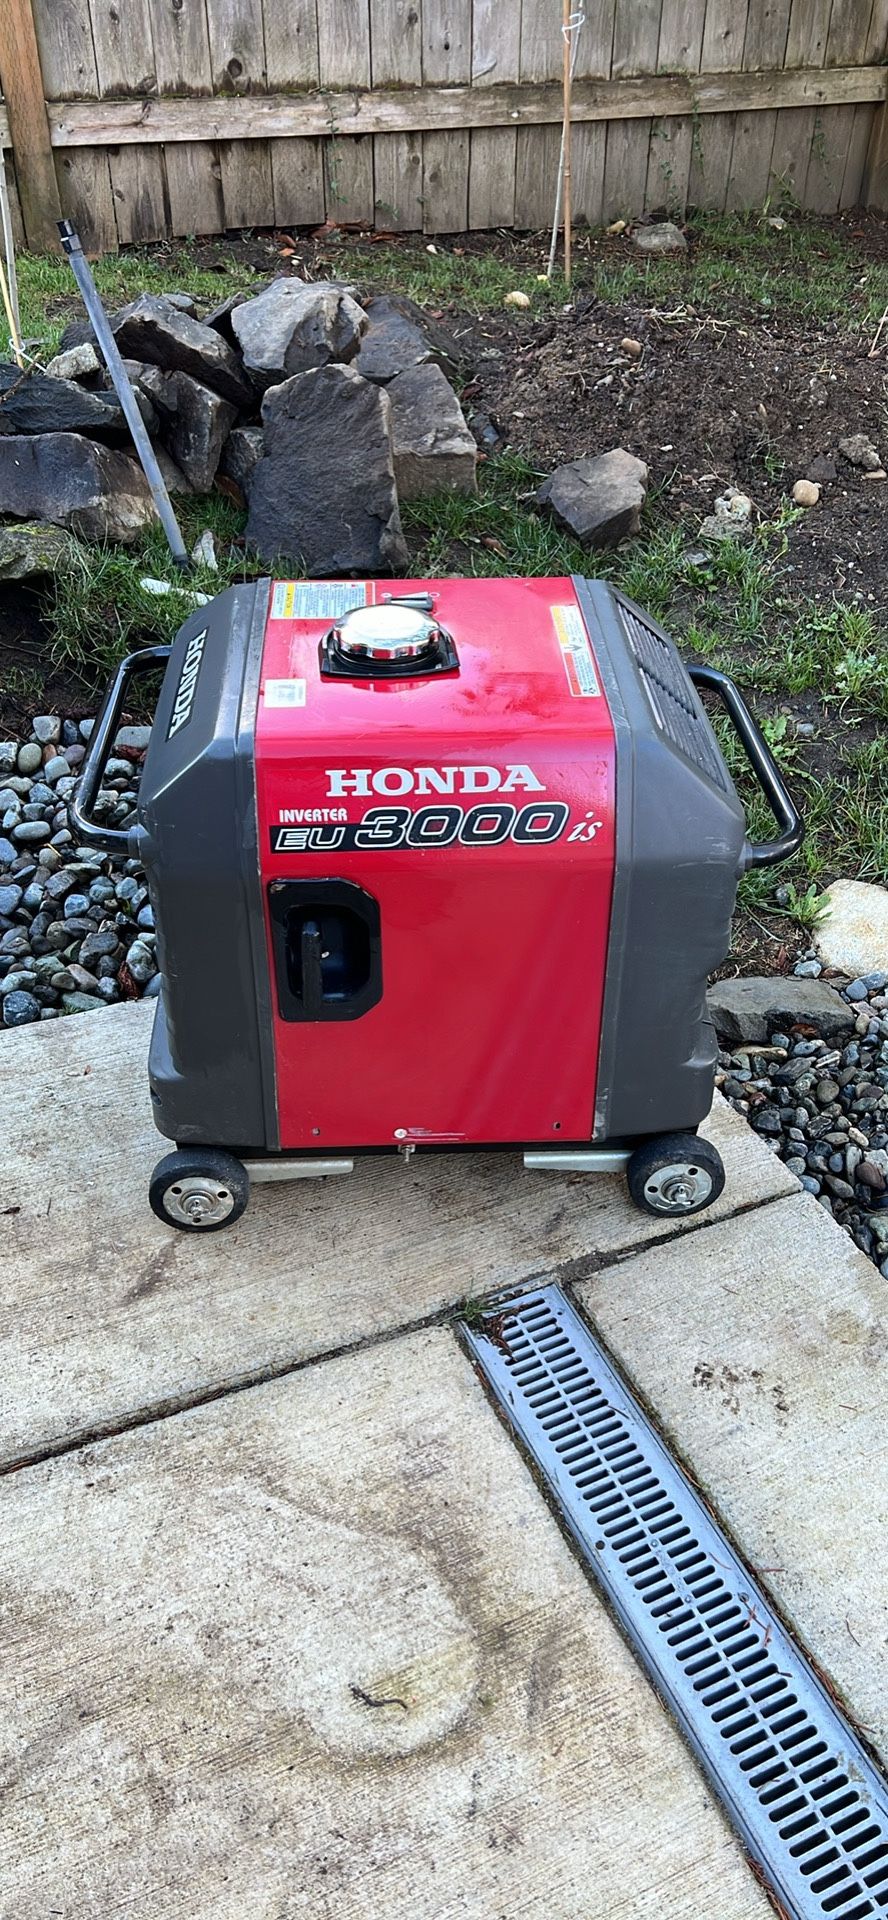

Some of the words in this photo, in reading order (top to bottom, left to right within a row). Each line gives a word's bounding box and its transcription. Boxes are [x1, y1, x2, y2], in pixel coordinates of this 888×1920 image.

[168, 629, 207, 739] HONDA
[325, 765, 546, 797] HONDA
[275, 826, 346, 850] EU
[354, 802, 569, 848] 3000
[568, 811, 602, 842] is
[279, 808, 348, 823] INVERTER
